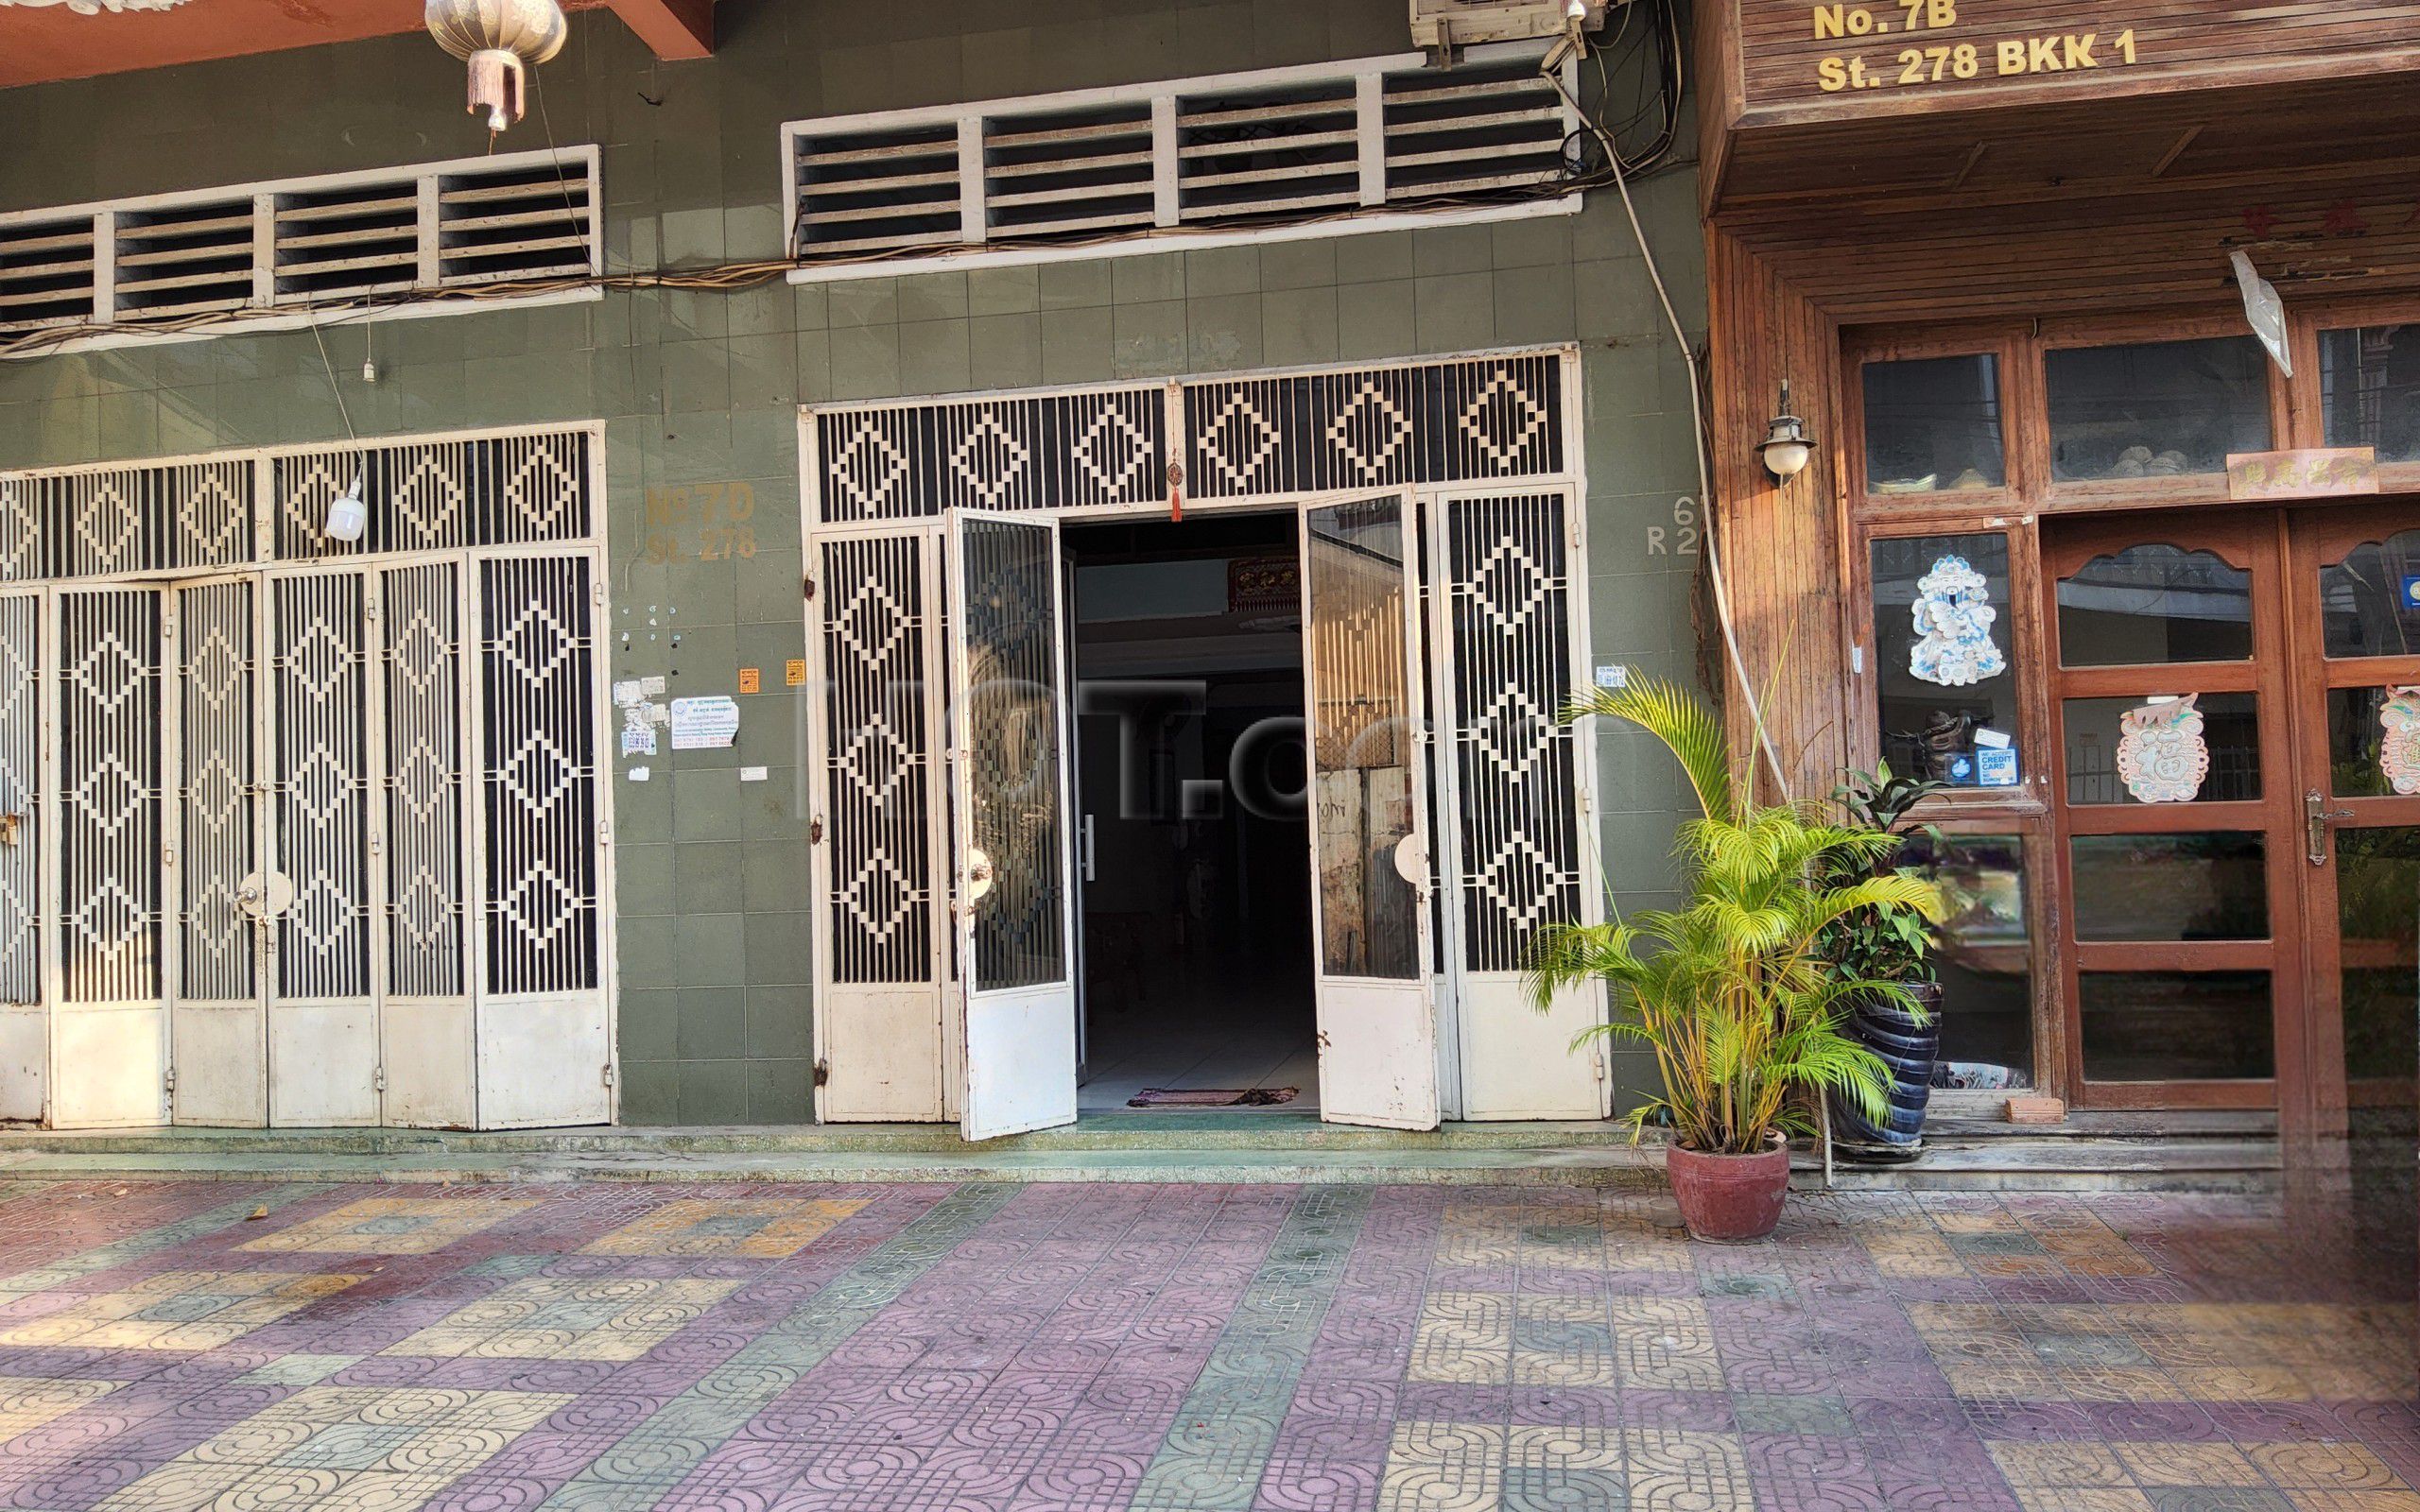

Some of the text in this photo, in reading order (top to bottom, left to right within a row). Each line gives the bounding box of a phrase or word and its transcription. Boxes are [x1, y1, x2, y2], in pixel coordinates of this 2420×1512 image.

[1814, 0, 1957, 40] No. 7B
[1818, 28, 2136, 91] St. 278 BKK 1
[1673, 496, 1696, 525] 6
[699, 527, 756, 561] 278
[2135, 730, 2190, 782] 福
